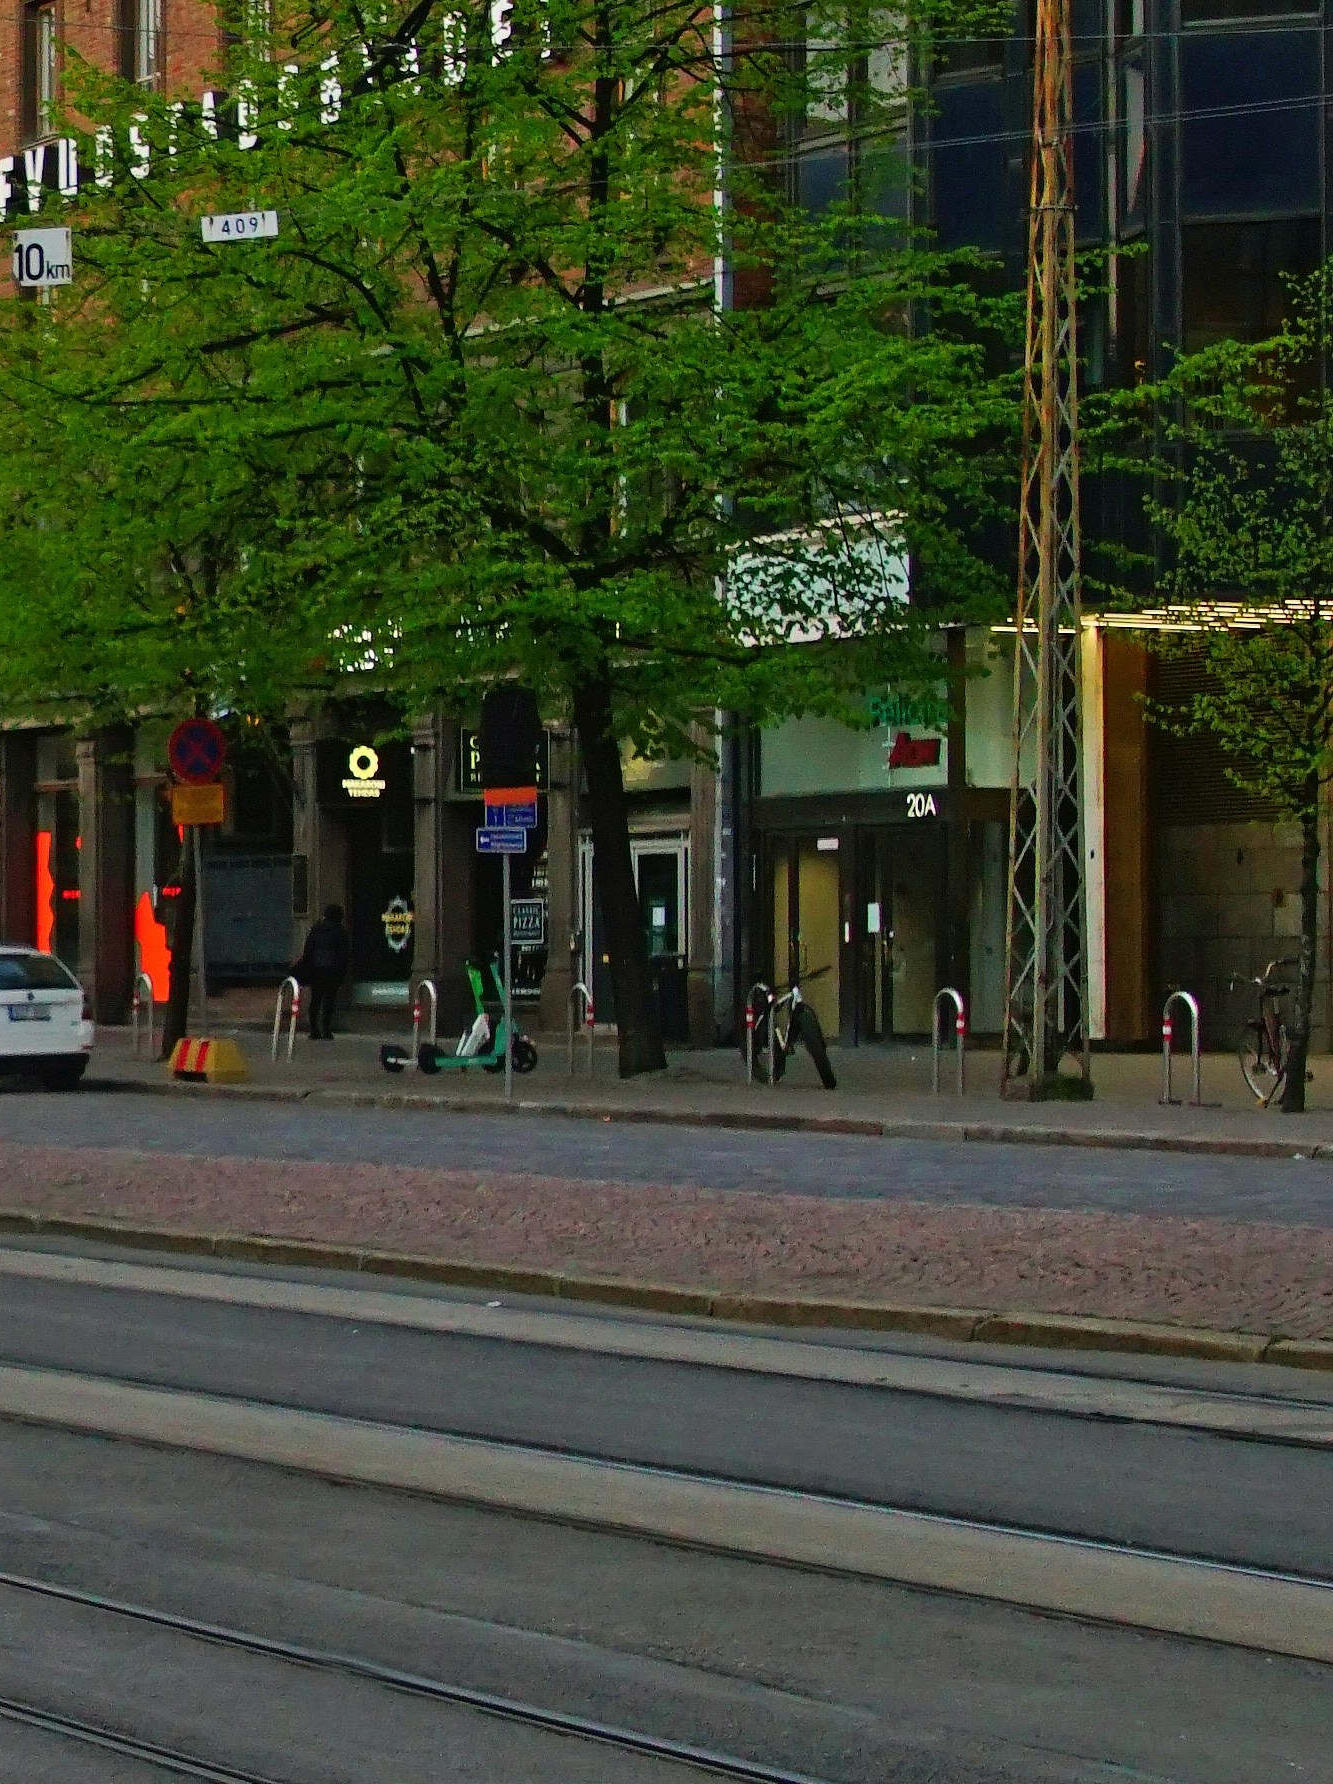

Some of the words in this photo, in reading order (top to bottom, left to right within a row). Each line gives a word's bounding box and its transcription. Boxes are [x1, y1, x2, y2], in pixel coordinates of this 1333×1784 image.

[220, 217, 259, 236] 409
[14, 243, 44, 281] 10
[46, 261, 70, 279] km
[906, 793, 936, 817] 20A
